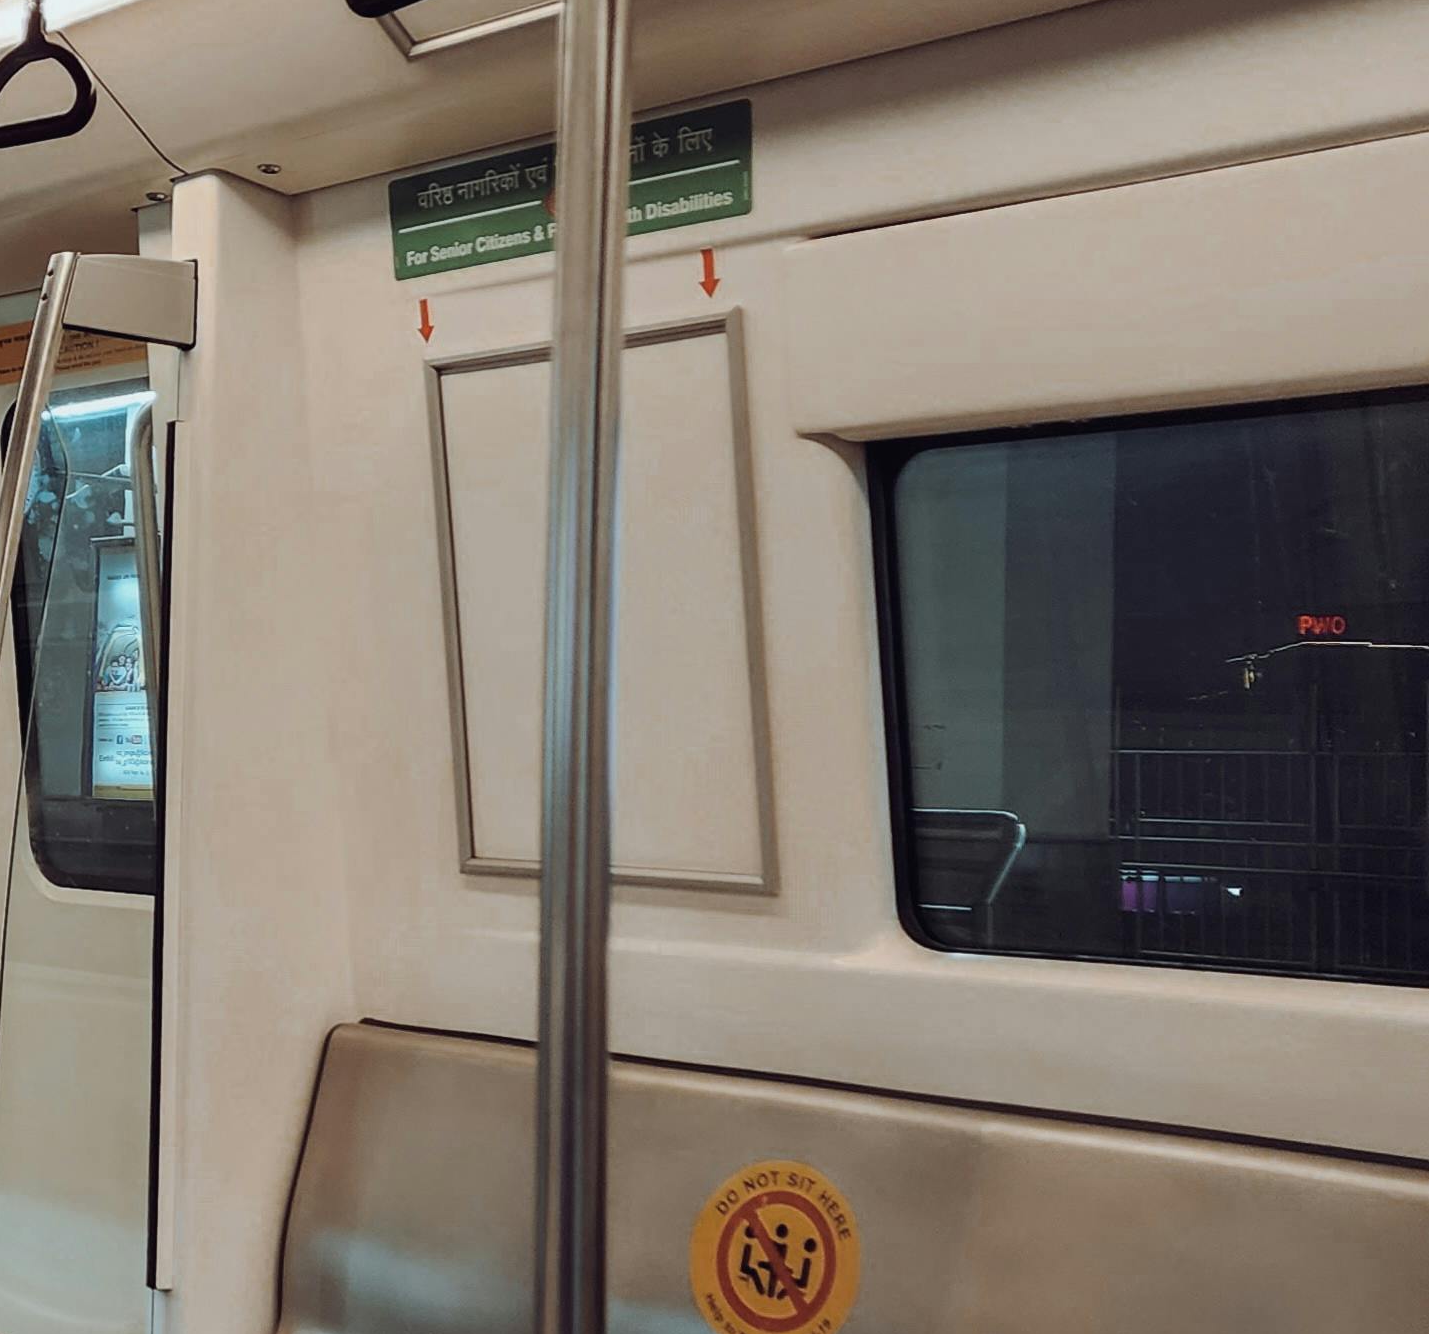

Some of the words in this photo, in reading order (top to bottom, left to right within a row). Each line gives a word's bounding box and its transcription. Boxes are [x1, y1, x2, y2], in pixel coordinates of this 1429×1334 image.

[652, 131, 670, 158] के
[677, 126, 713, 154] लिए
[645, 191, 734, 220] Disabilities
[406, 249, 429, 267] For
[430, 241, 473, 262] Senior
[475, 230, 531, 253] Citizens
[533, 224, 545, 242] &
[715, 1188, 739, 1217] DO
[743, 1170, 780, 1192] NOT
[787, 1172, 816, 1191] SIT
[819, 1190, 852, 1241] HERE
